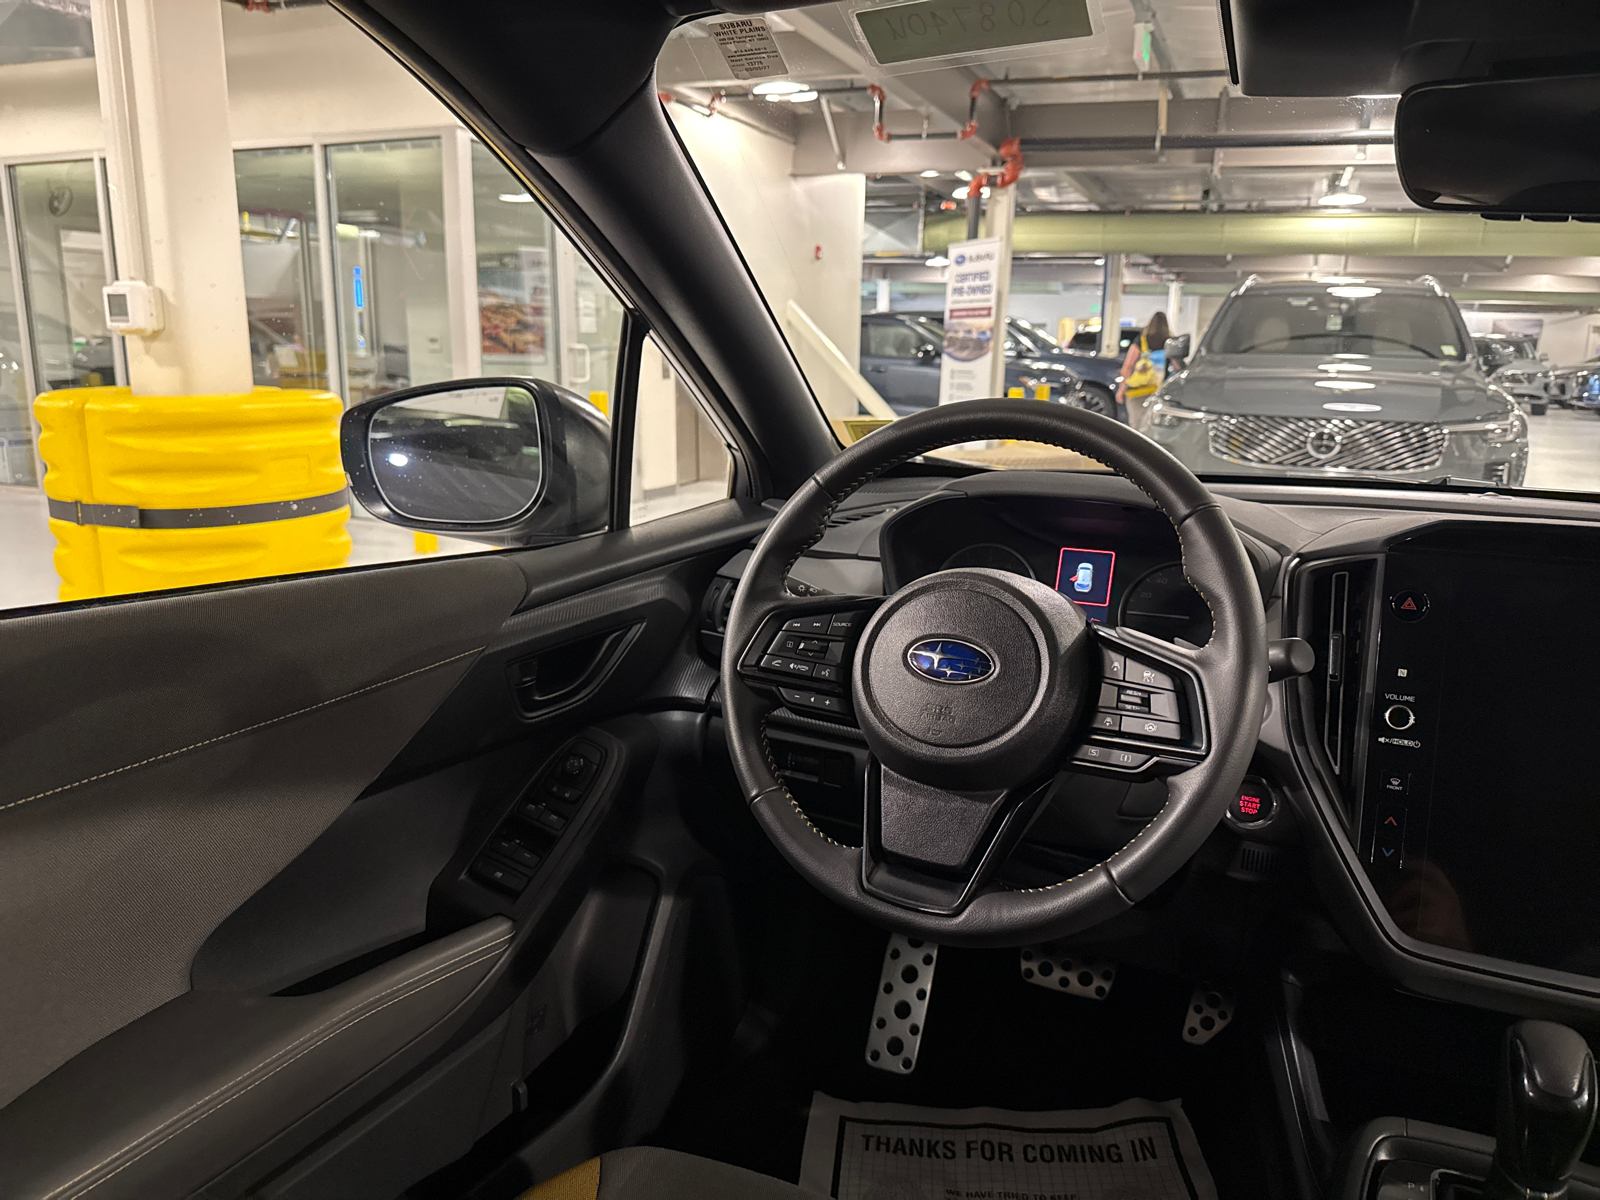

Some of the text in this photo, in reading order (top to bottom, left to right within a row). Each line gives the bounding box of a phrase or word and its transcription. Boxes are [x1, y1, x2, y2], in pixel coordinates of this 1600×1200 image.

[719, 20, 753, 30] SUBARU
[714, 26, 766, 37] WHITE PLAINS
[1384, 693, 1416, 702] VOLUME
[1240, 794, 1260, 803] ENGINE
[1239, 801, 1260, 809] START
[1240, 806, 1258, 815] STOP
[861, 1134, 1158, 1164] THANKS FOR COMING IN
[966, 1190, 993, 1198] HAVE
[997, 1191, 1029, 1200] TRIED
